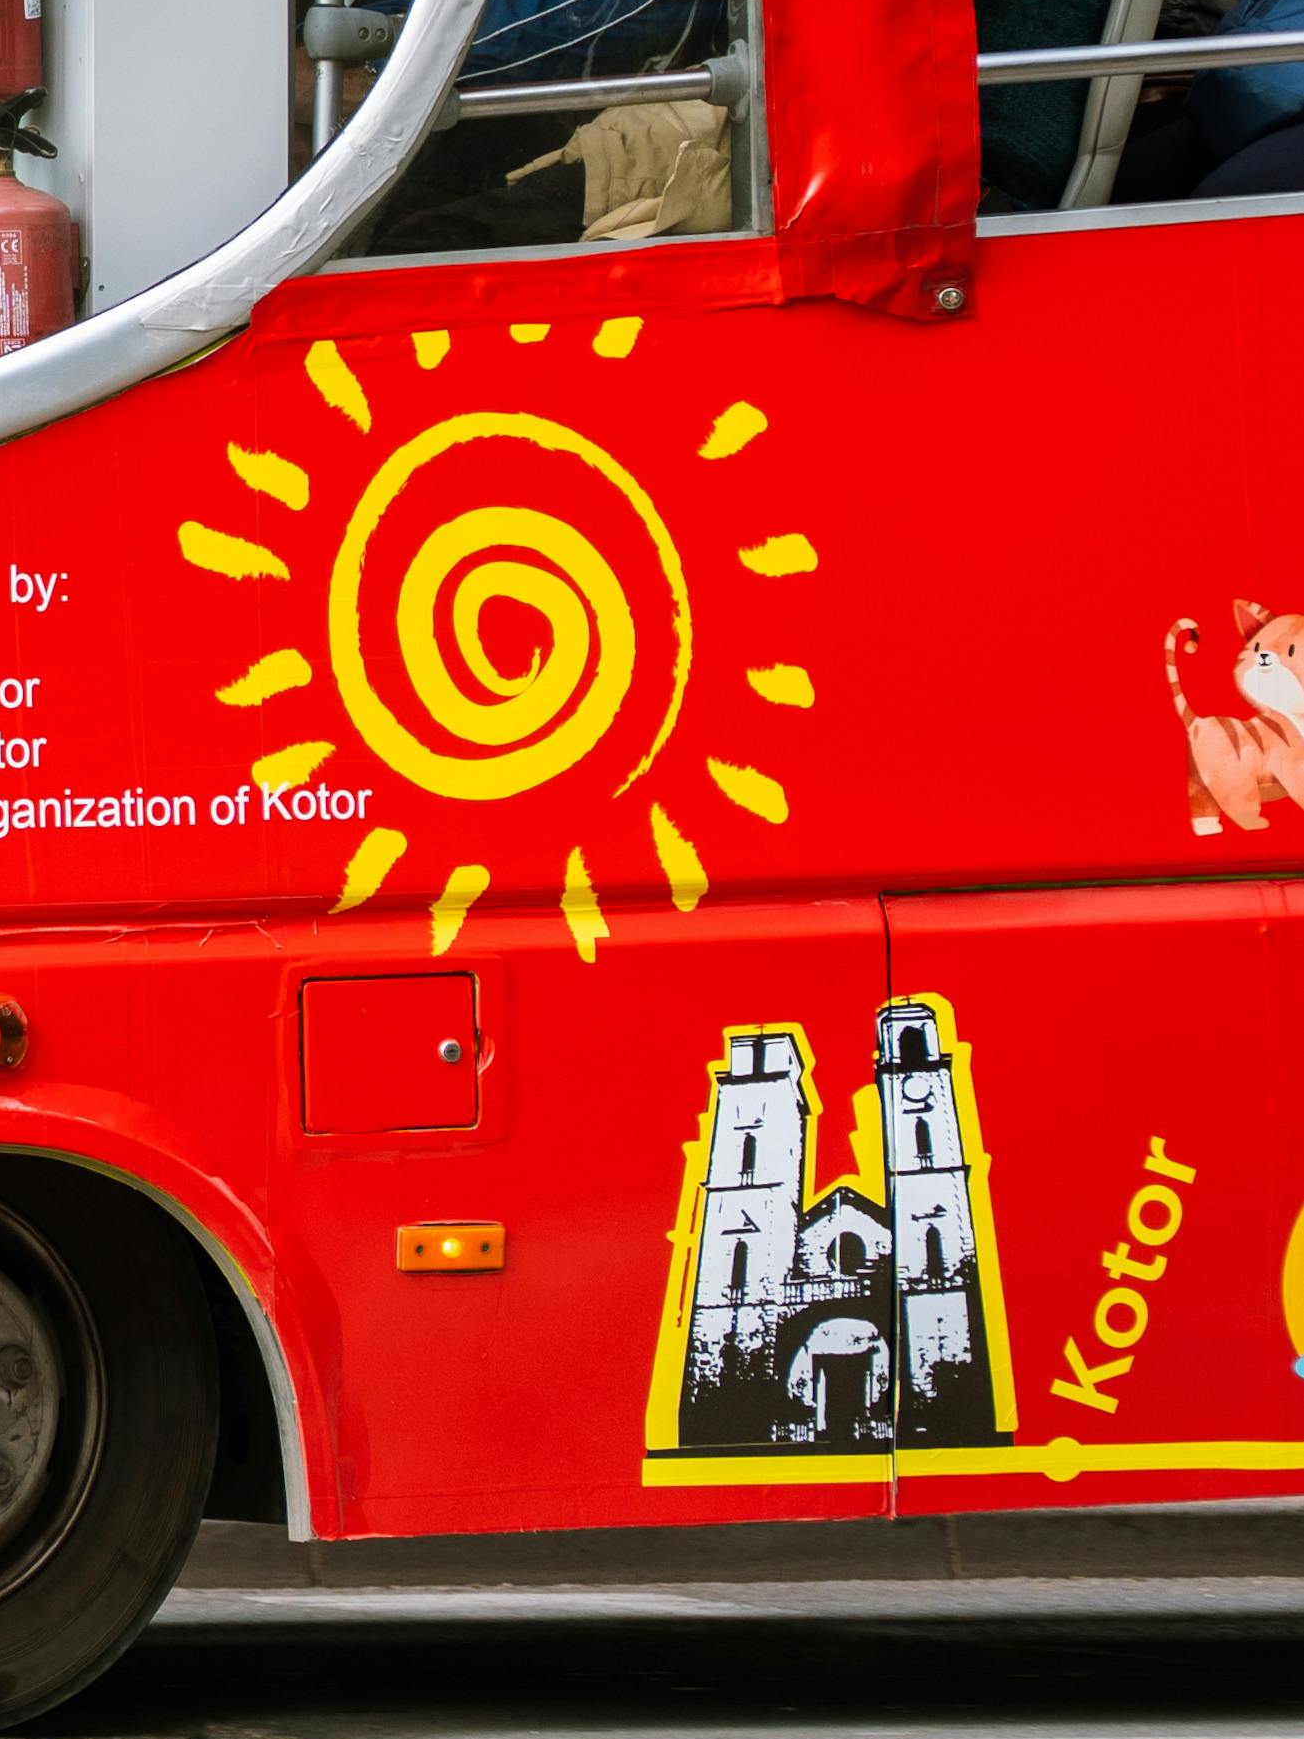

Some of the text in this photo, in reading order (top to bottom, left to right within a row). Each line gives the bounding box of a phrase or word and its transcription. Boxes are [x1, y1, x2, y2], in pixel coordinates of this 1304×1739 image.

[10, 564, 68, 612] by:
[210, 785, 251, 826] of
[260, 781, 373, 821] Kotor
[1050, 1136, 1197, 1414] Kotor
